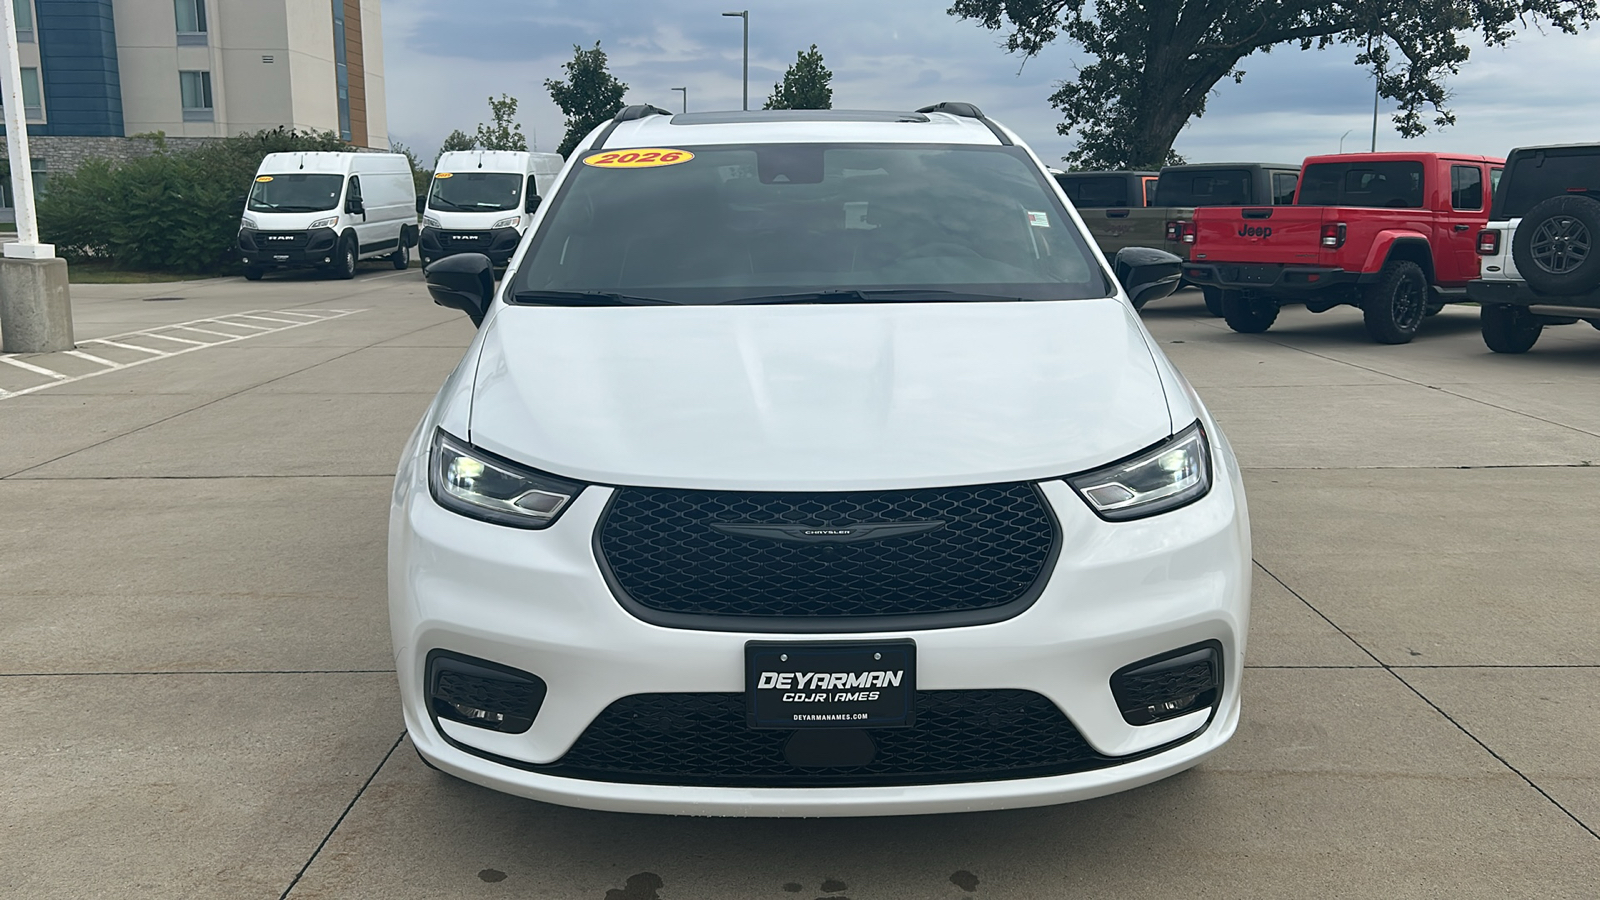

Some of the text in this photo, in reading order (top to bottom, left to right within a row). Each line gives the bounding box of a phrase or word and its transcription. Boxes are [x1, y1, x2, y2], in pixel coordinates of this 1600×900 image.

[594, 152, 683, 164] 2026
[1238, 223, 1272, 239] Jeep
[757, 670, 904, 690] DEYARMAN
[782, 691, 880, 703] CDJR AMES
[793, 713, 868, 721] DEYARMANAMES.COM
